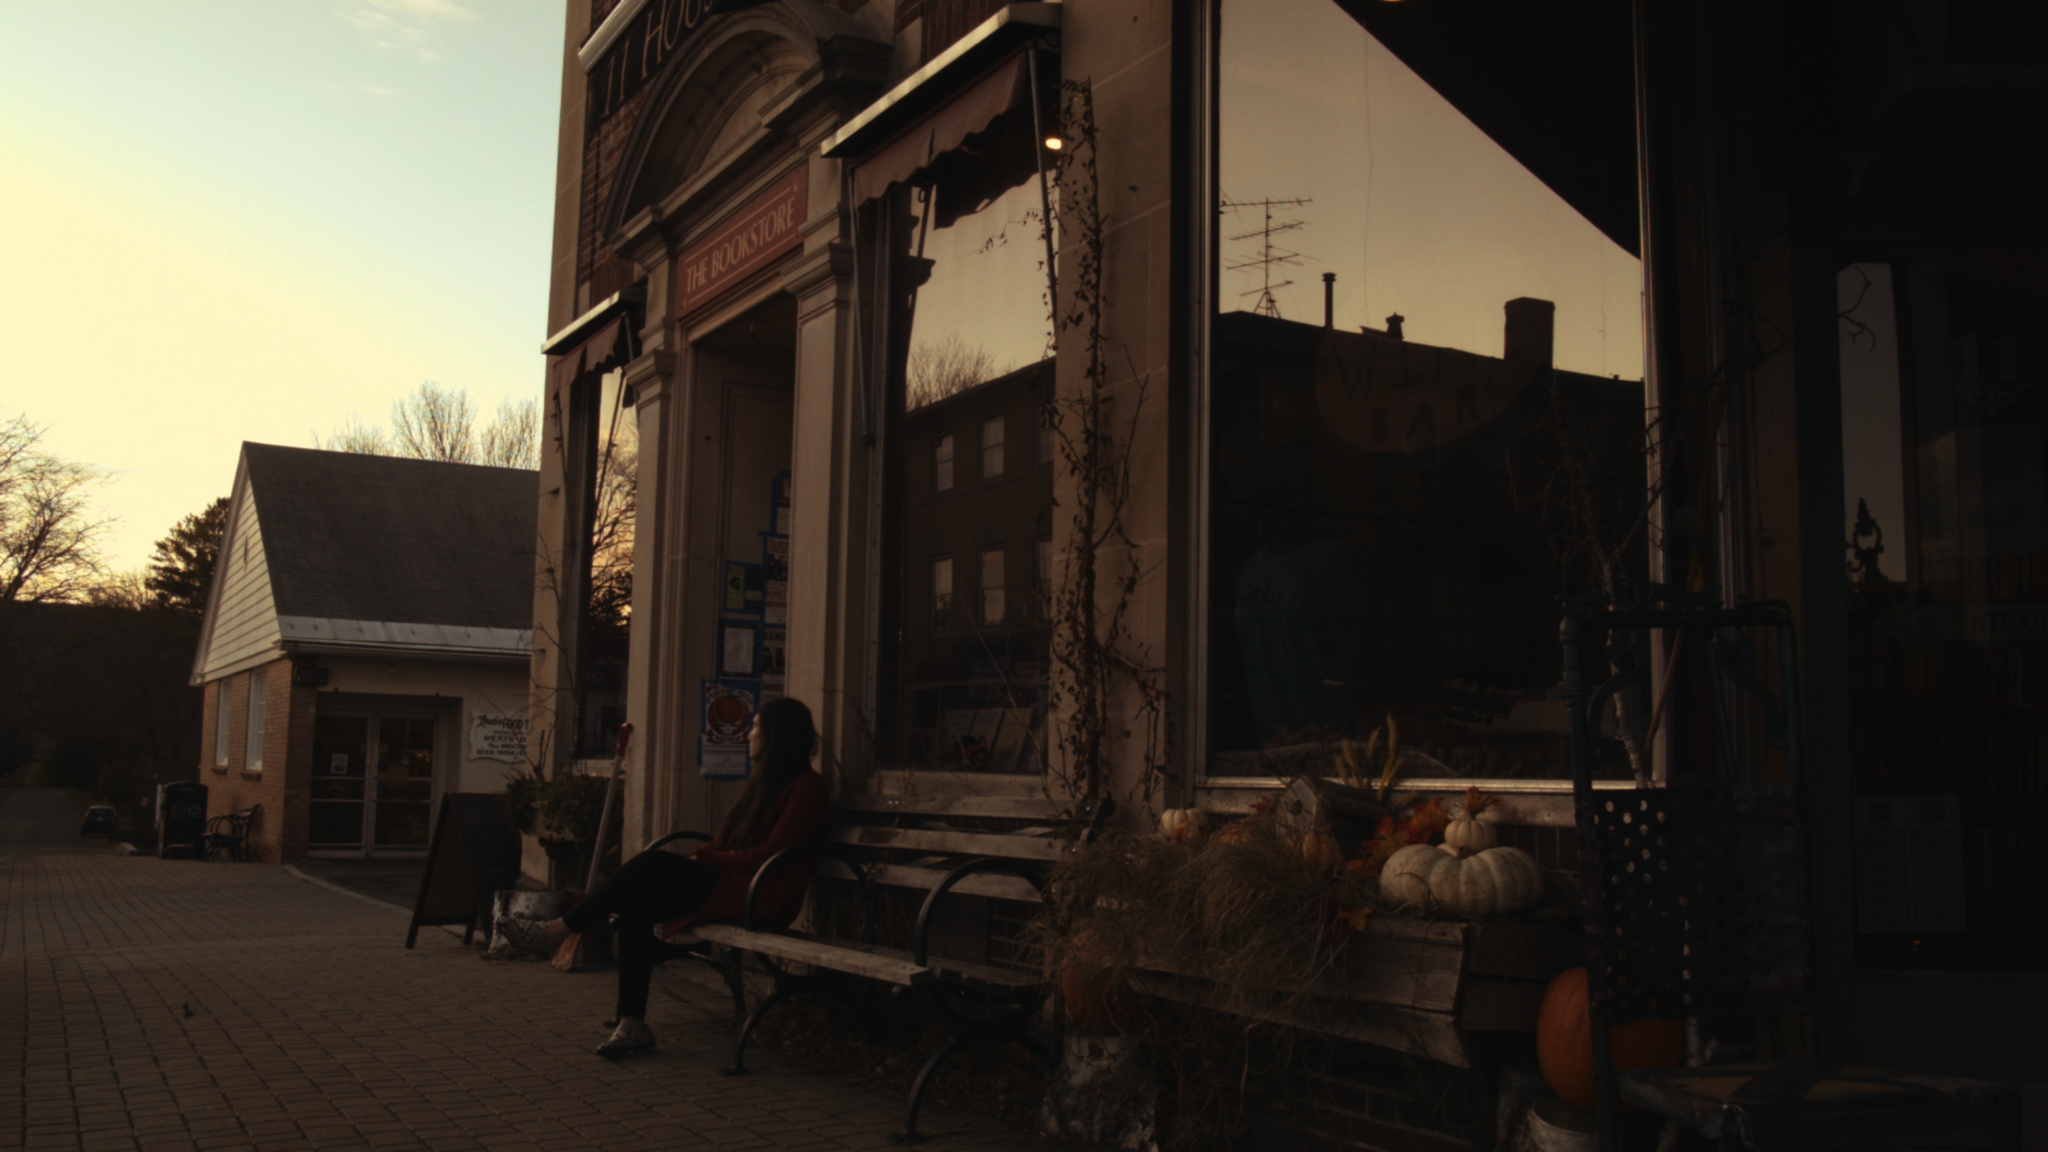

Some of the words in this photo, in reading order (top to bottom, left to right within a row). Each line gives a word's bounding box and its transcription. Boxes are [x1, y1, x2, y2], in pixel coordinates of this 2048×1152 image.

[686, 255, 709, 294] THE
[711, 196, 796, 279] BOOKSTORE
[1370, 383, 1482, 446] BAR
